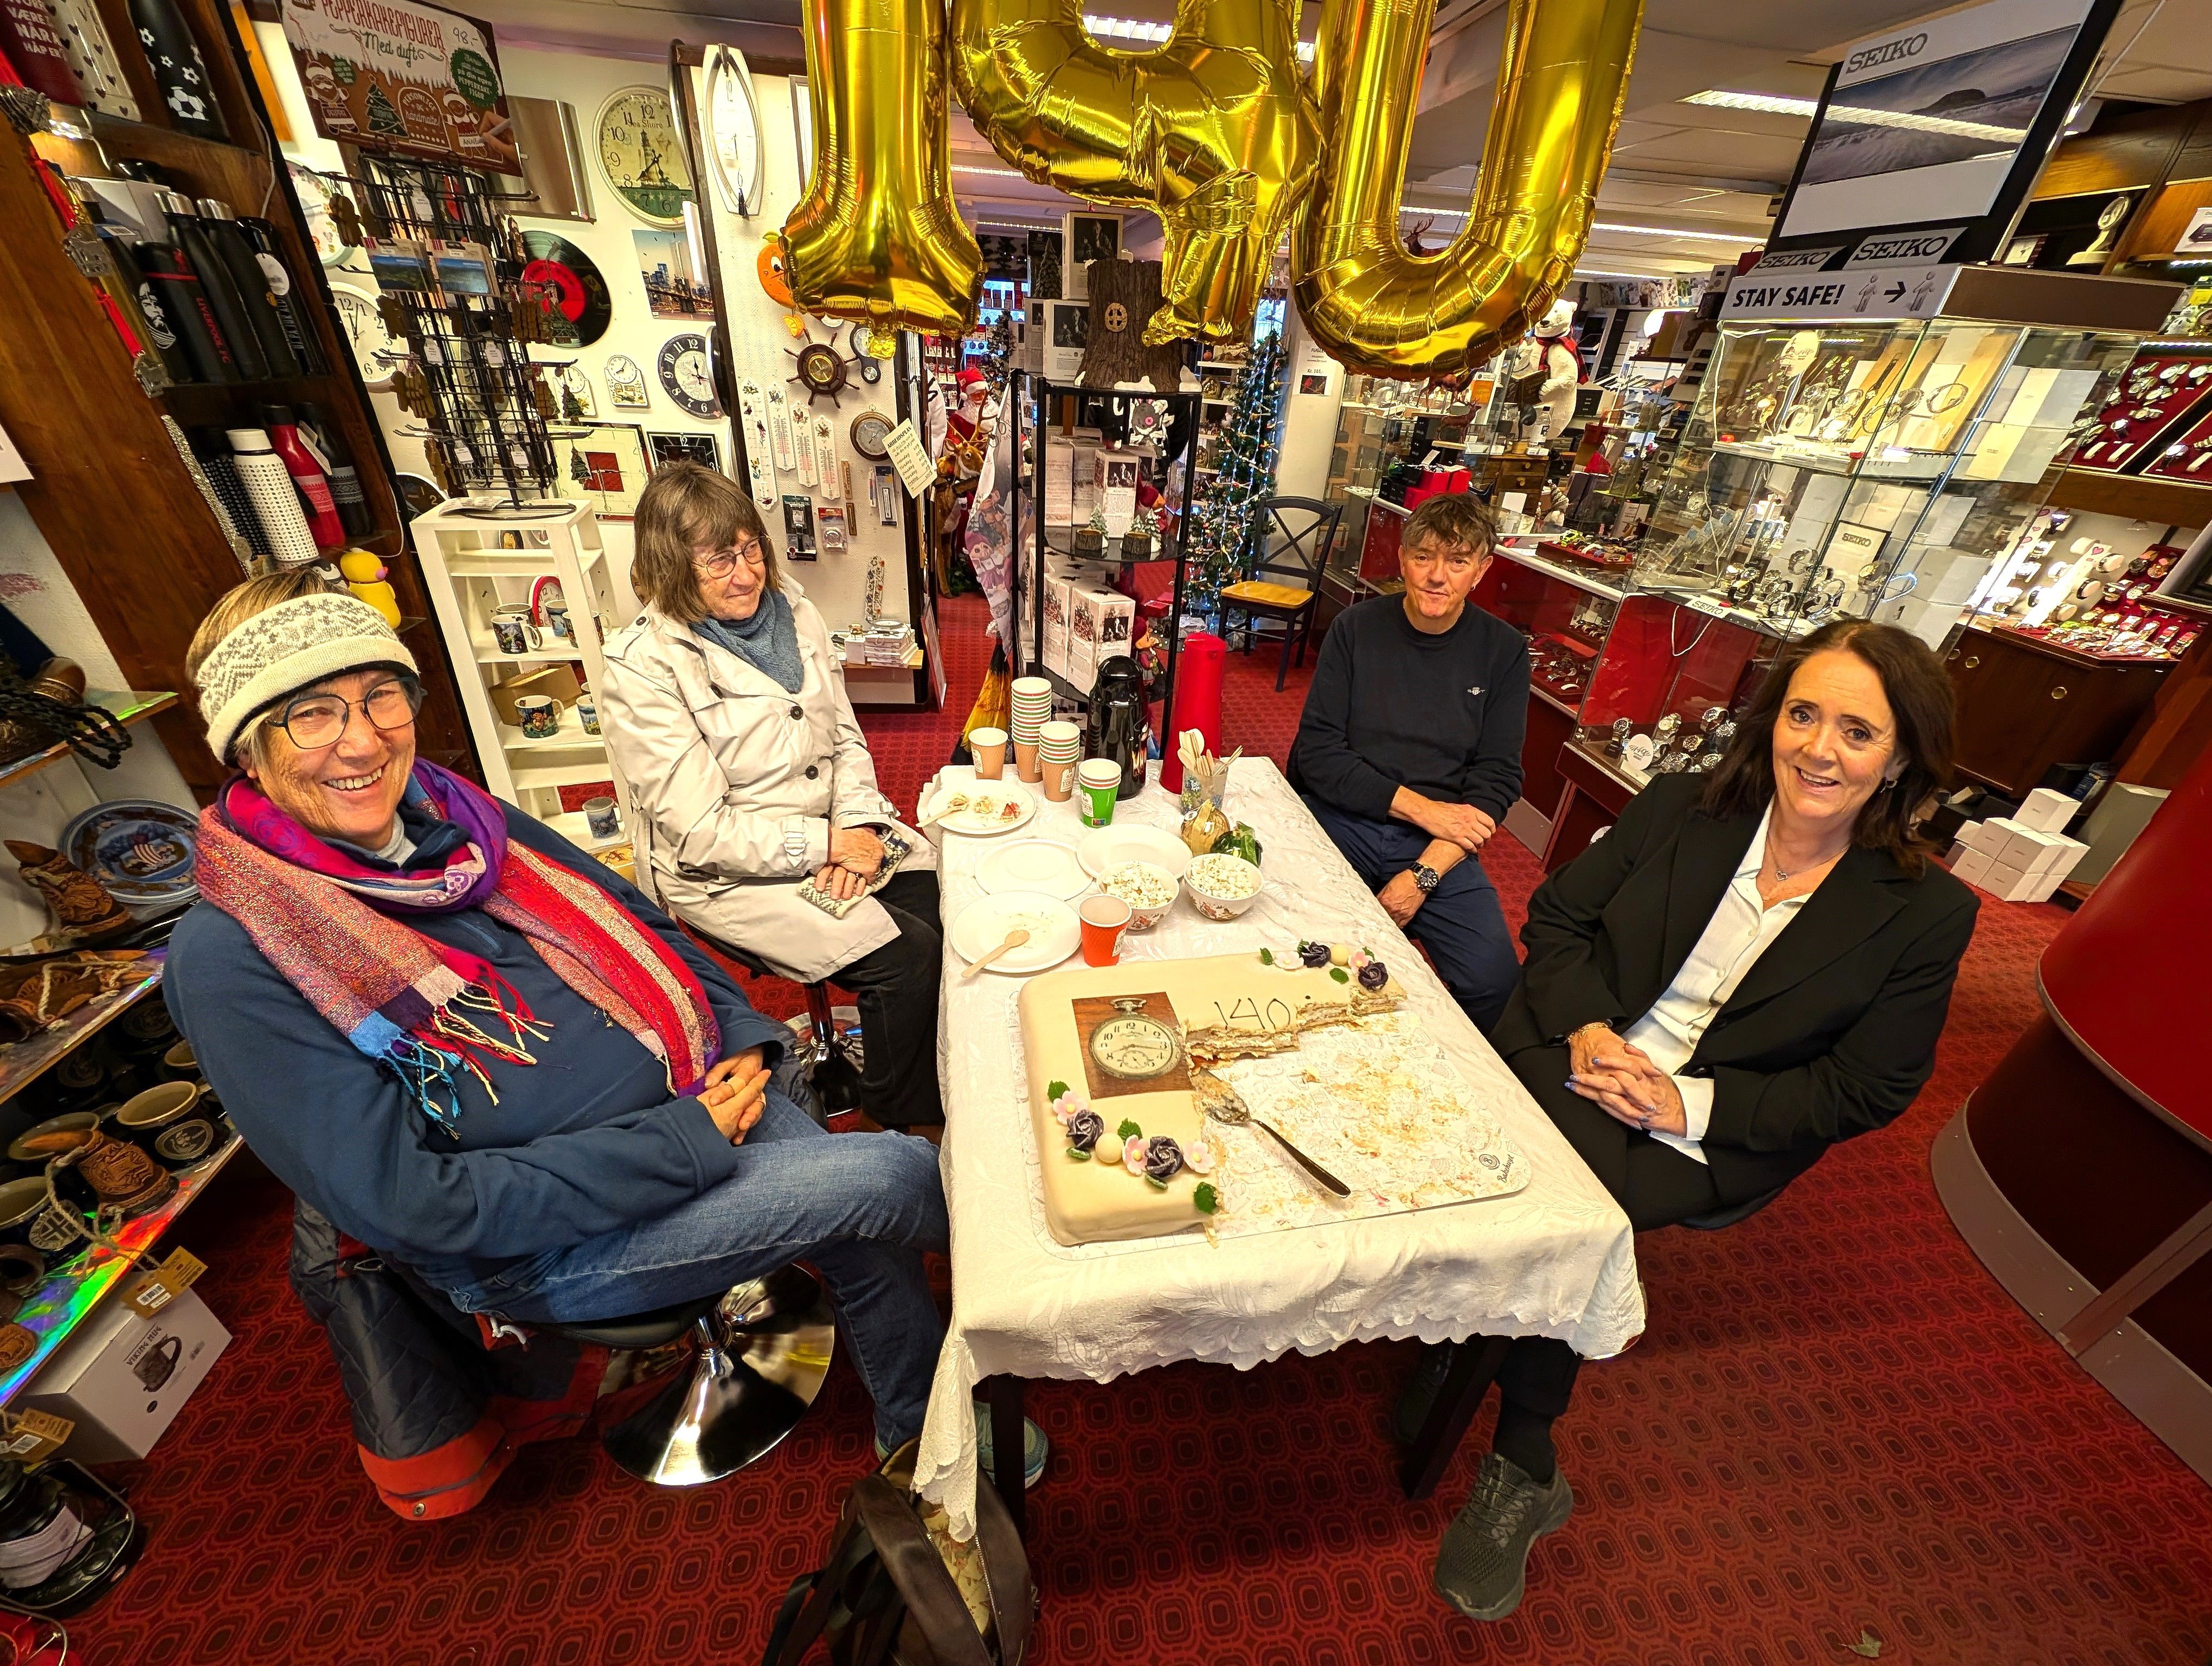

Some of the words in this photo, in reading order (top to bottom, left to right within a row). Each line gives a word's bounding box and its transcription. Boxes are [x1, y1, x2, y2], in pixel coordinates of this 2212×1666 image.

[359, 30, 394, 56] Med
[396, 42, 418, 68] duft
[1846, 33, 1929, 74] SEIKO
[640, 104, 655, 119] 12
[642, 119, 664, 129] Shore
[610, 126, 626, 142] 10
[610, 151, 621, 167] 9
[623, 174, 633, 188] 8
[661, 199, 672, 213] 6
[1851, 236, 1949, 262] SEIKO
[1756, 251, 1831, 270] SEIKO
[1732, 287, 1783, 307] STAY
[1782, 284, 1846, 306] SAFE!
[338, 298, 354, 311] 12
[374, 316, 384, 329] 2
[673, 341, 685, 354] 11
[686, 338, 699, 349] 12
[664, 353, 676, 365] 10
[363, 362, 373, 375] 6
[672, 387, 681, 396] 8
[700, 402, 708, 413] 6
[429, 495, 438, 505] 2
[1842, 532, 1872, 547] SEIKO
[1692, 600, 1724, 616] SEIKO
[1214, 998, 1291, 1032] 140
[1126, 1022, 1136, 1030] 12
[1104, 1033, 1113, 1041] 10
[1483, 1157, 1493, 1165] B
[1497, 1153, 1515, 1183] Bakehuset
[125, 1341, 150, 1366] VIKING
